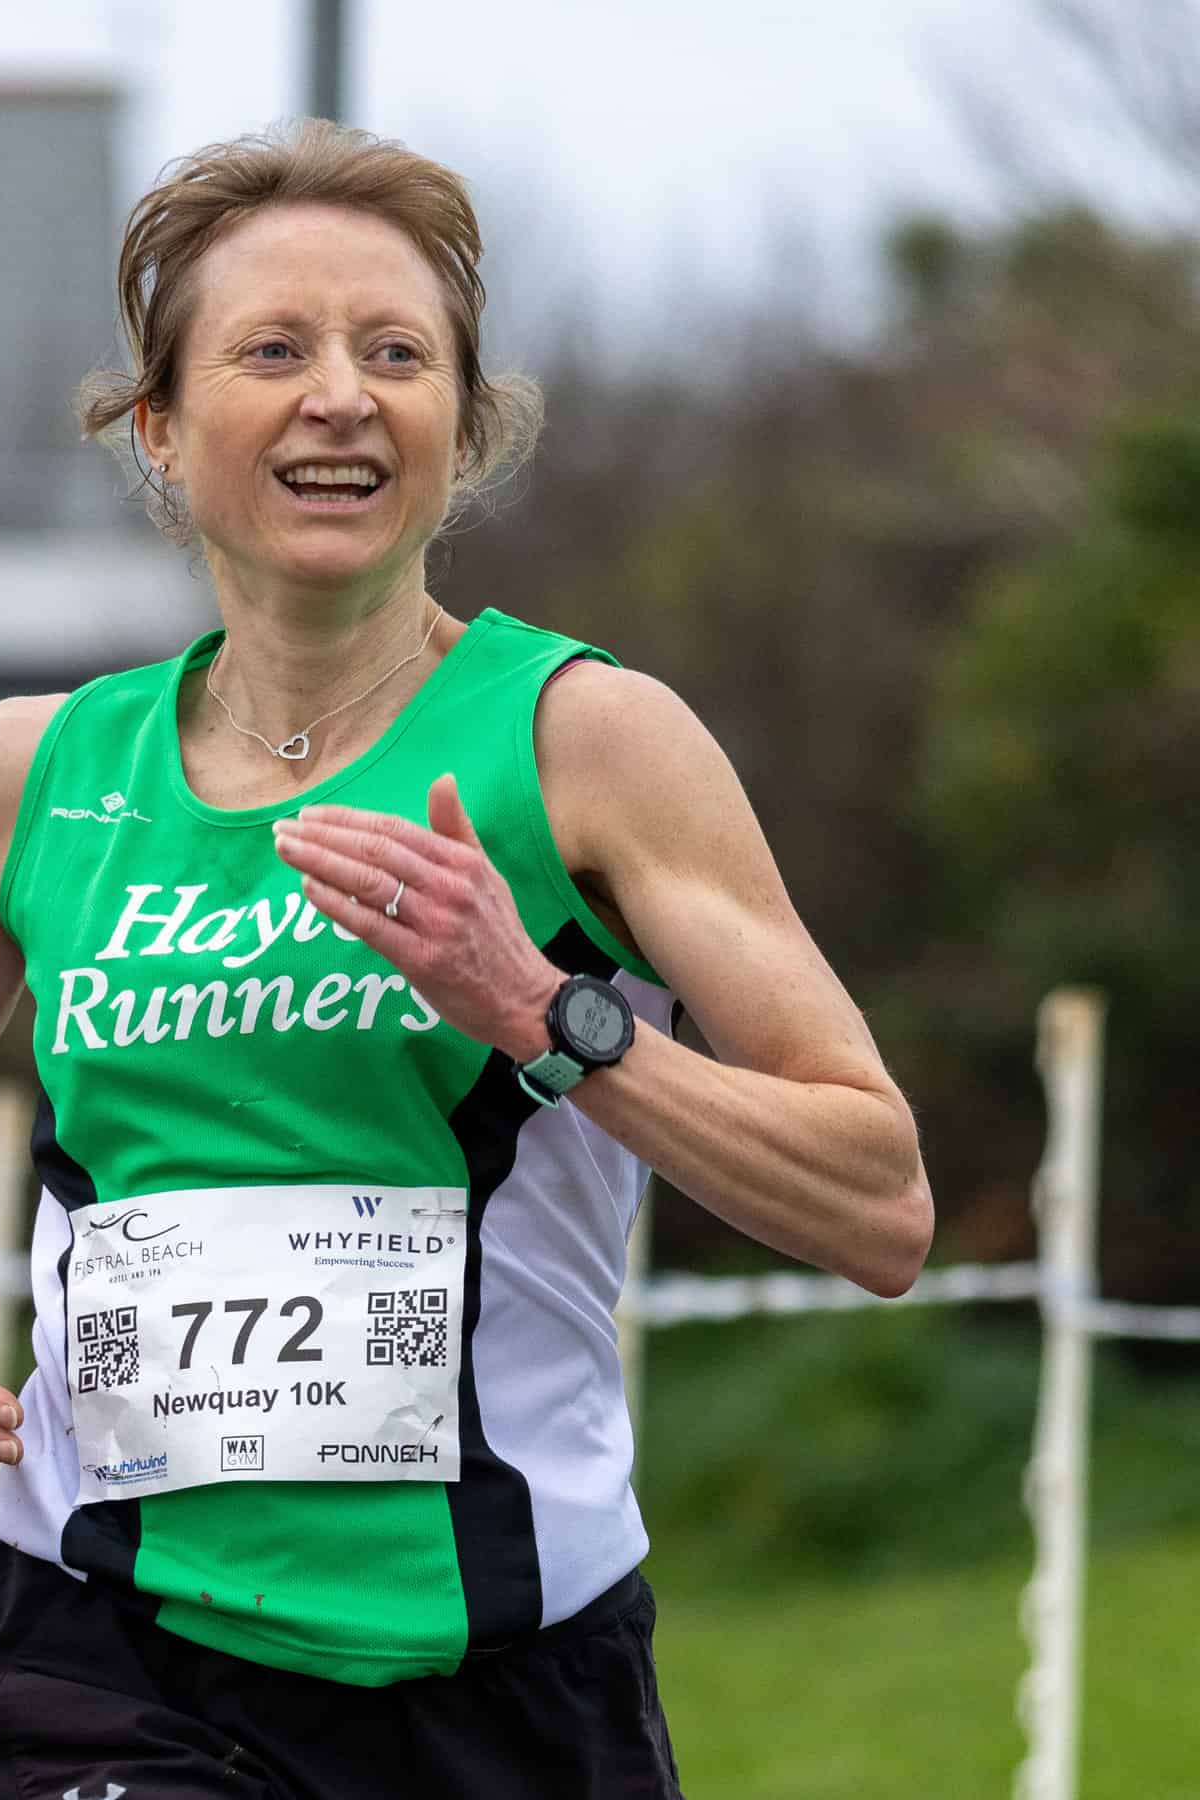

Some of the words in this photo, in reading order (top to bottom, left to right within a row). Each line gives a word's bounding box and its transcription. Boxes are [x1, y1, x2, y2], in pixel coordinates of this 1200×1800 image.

[95, 884, 360, 968] Hayl
[51, 968, 441, 1054] Runners
[75, 1250, 134, 1277] FISTRAL
[141, 1240, 202, 1263] BEACH
[314, 1256, 375, 1268] Empowering
[377, 1257, 415, 1268] Success
[171, 1295, 323, 1370] 772
[153, 1388, 279, 1418] Newquay
[290, 1381, 347, 1406] 10K
[227, 1439, 258, 1454] WAX
[227, 1452, 258, 1466] GYM
